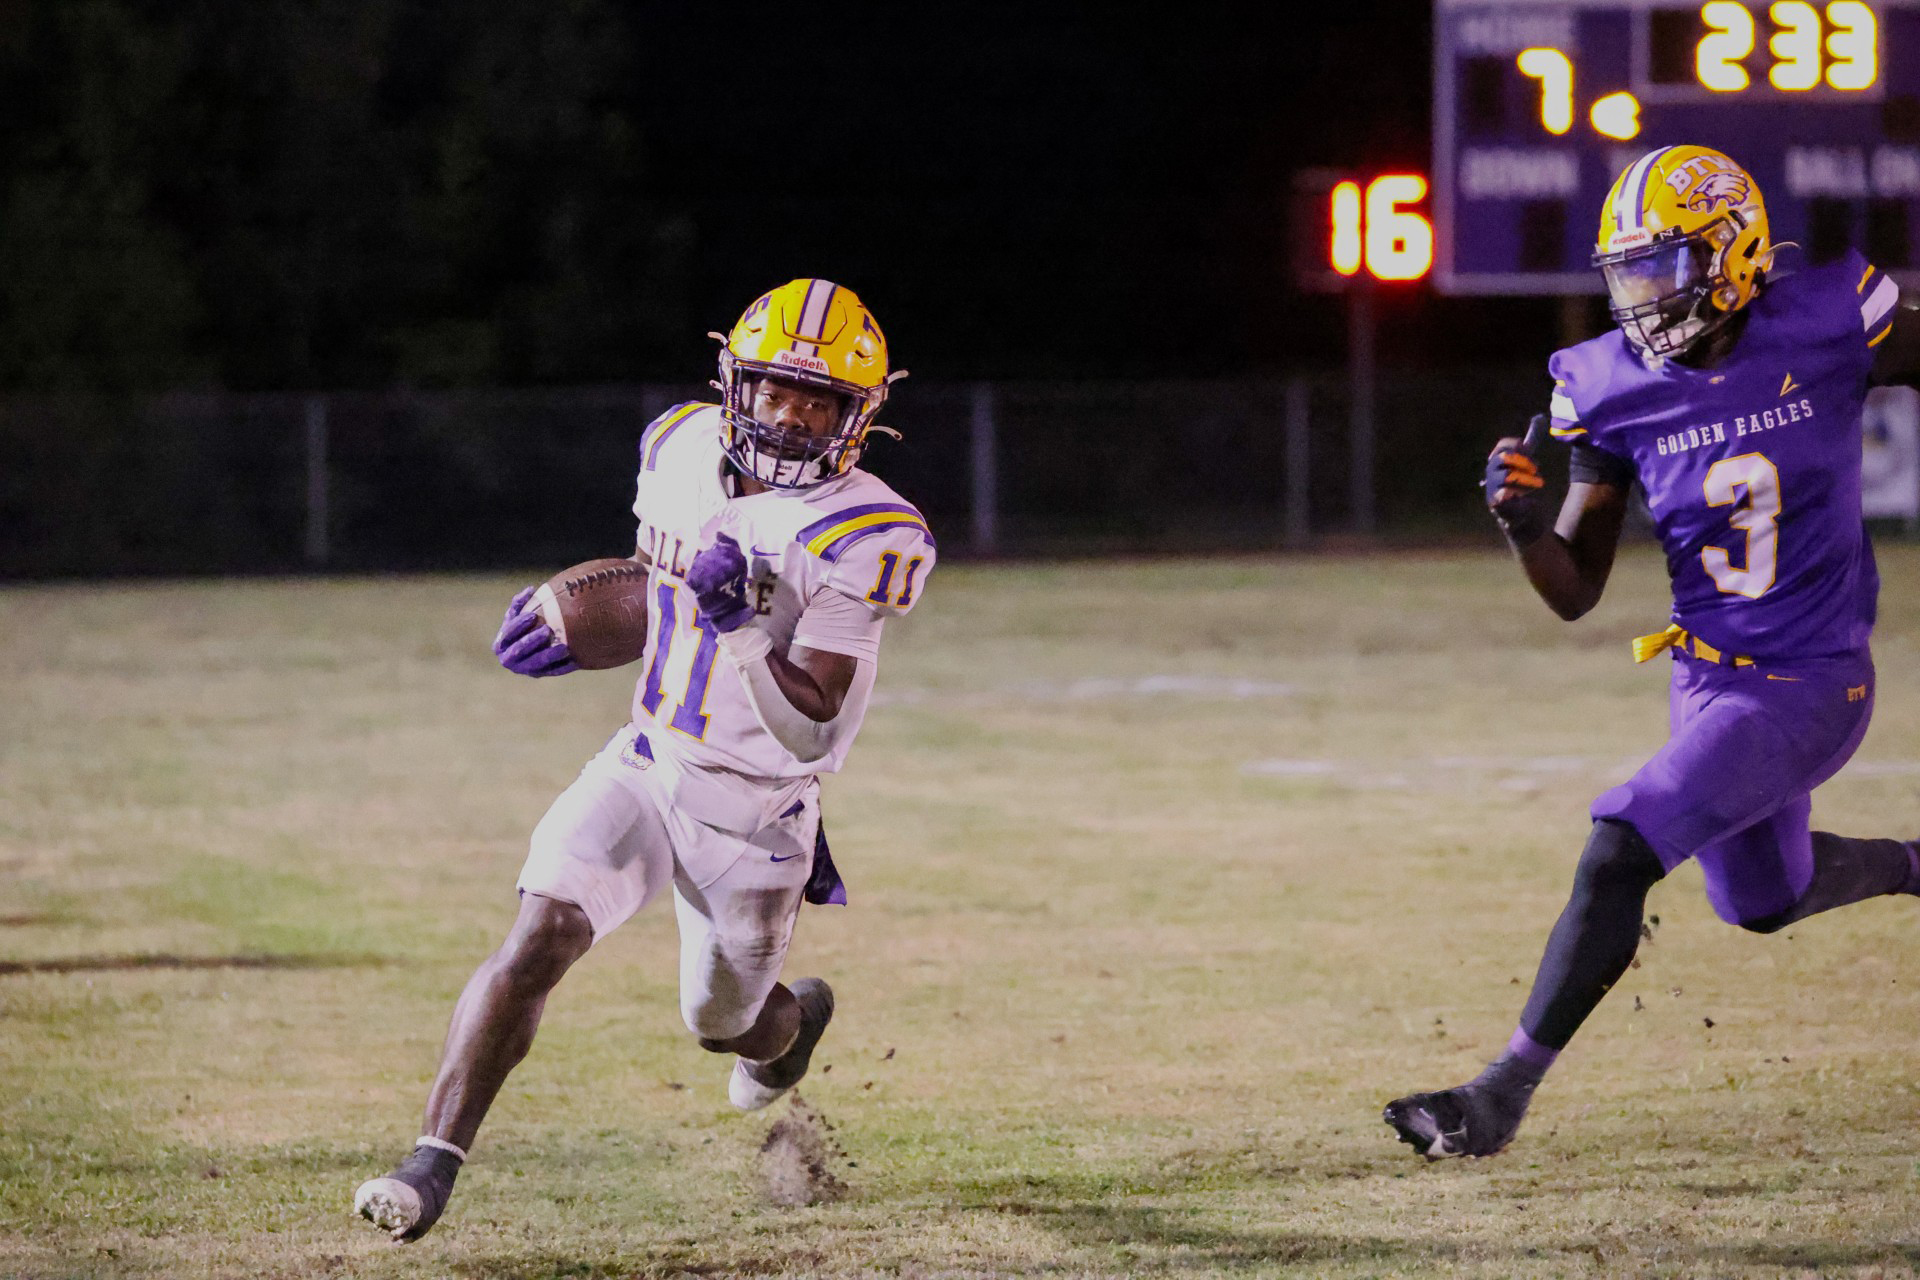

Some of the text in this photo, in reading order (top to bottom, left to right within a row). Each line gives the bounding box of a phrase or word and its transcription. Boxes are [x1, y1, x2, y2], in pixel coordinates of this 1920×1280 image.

[1517, 47, 1573, 135] 7
[1665, 156, 1741, 196] BTW
[1331, 174, 1433, 281] 16
[780, 353, 826, 371] Riddell
[1656, 399, 1814, 456] GOLDEN EAGLES
[1701, 452, 1782, 599] 3
[864, 549, 923, 608] 11
[641, 579, 720, 742] 11
